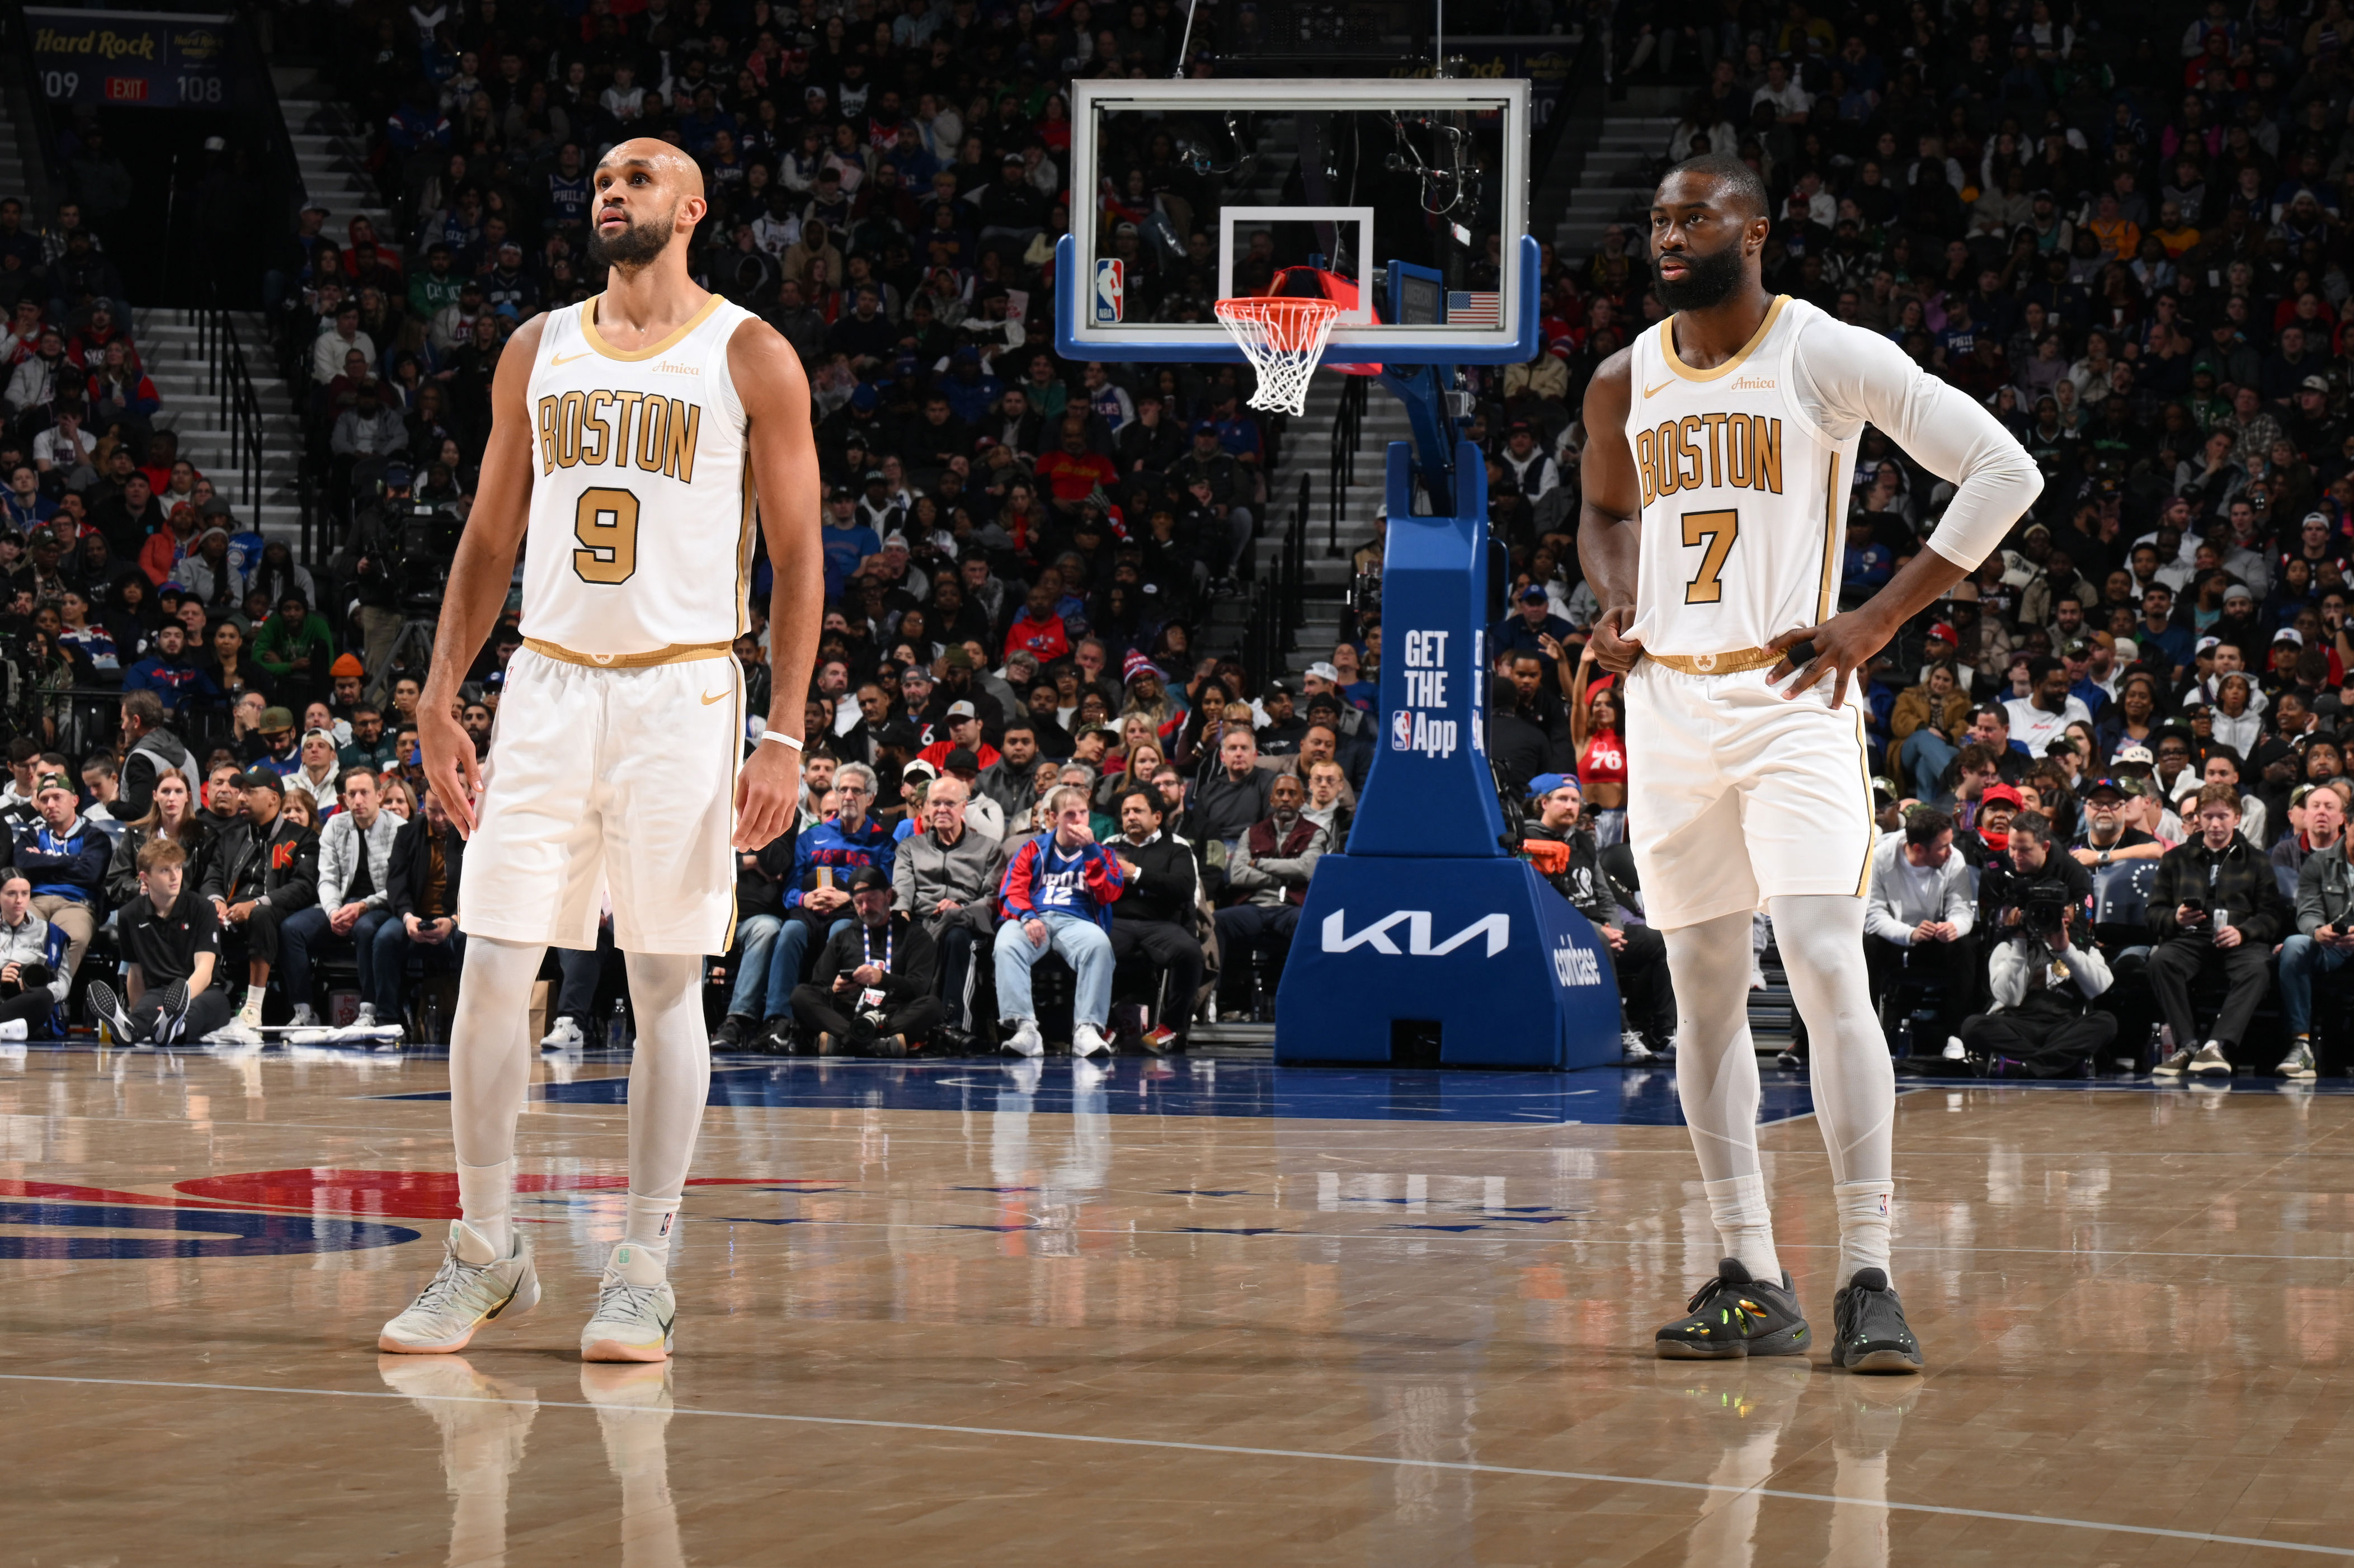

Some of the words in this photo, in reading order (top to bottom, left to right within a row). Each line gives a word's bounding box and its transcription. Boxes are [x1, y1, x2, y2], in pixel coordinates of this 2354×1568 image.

[35, 28, 95, 53] Hard
[97, 30, 155, 60] Rock
[40, 70, 79, 98] 09
[113, 79, 143, 98] EXIT
[177, 76, 222, 103] 108
[1098, 308, 1113, 319] NBA
[652, 360, 699, 376] Amica
[1731, 376, 1776, 390] Amica
[539, 389, 701, 484] BOSTON
[1636, 412, 1783, 510] BOSTON
[573, 486, 641, 585] 9
[1681, 508, 1739, 605] 7
[1405, 629, 1449, 667] GET
[1404, 670, 1448, 708] THE
[920, 723, 935, 746] 76
[1412, 712, 1457, 759] App
[1590, 750, 1623, 770] 76
[272, 840, 297, 869] K
[1042, 885, 1073, 905] 12
[1322, 908, 1510, 958] KIA
[1553, 933, 1600, 987] coinbase
